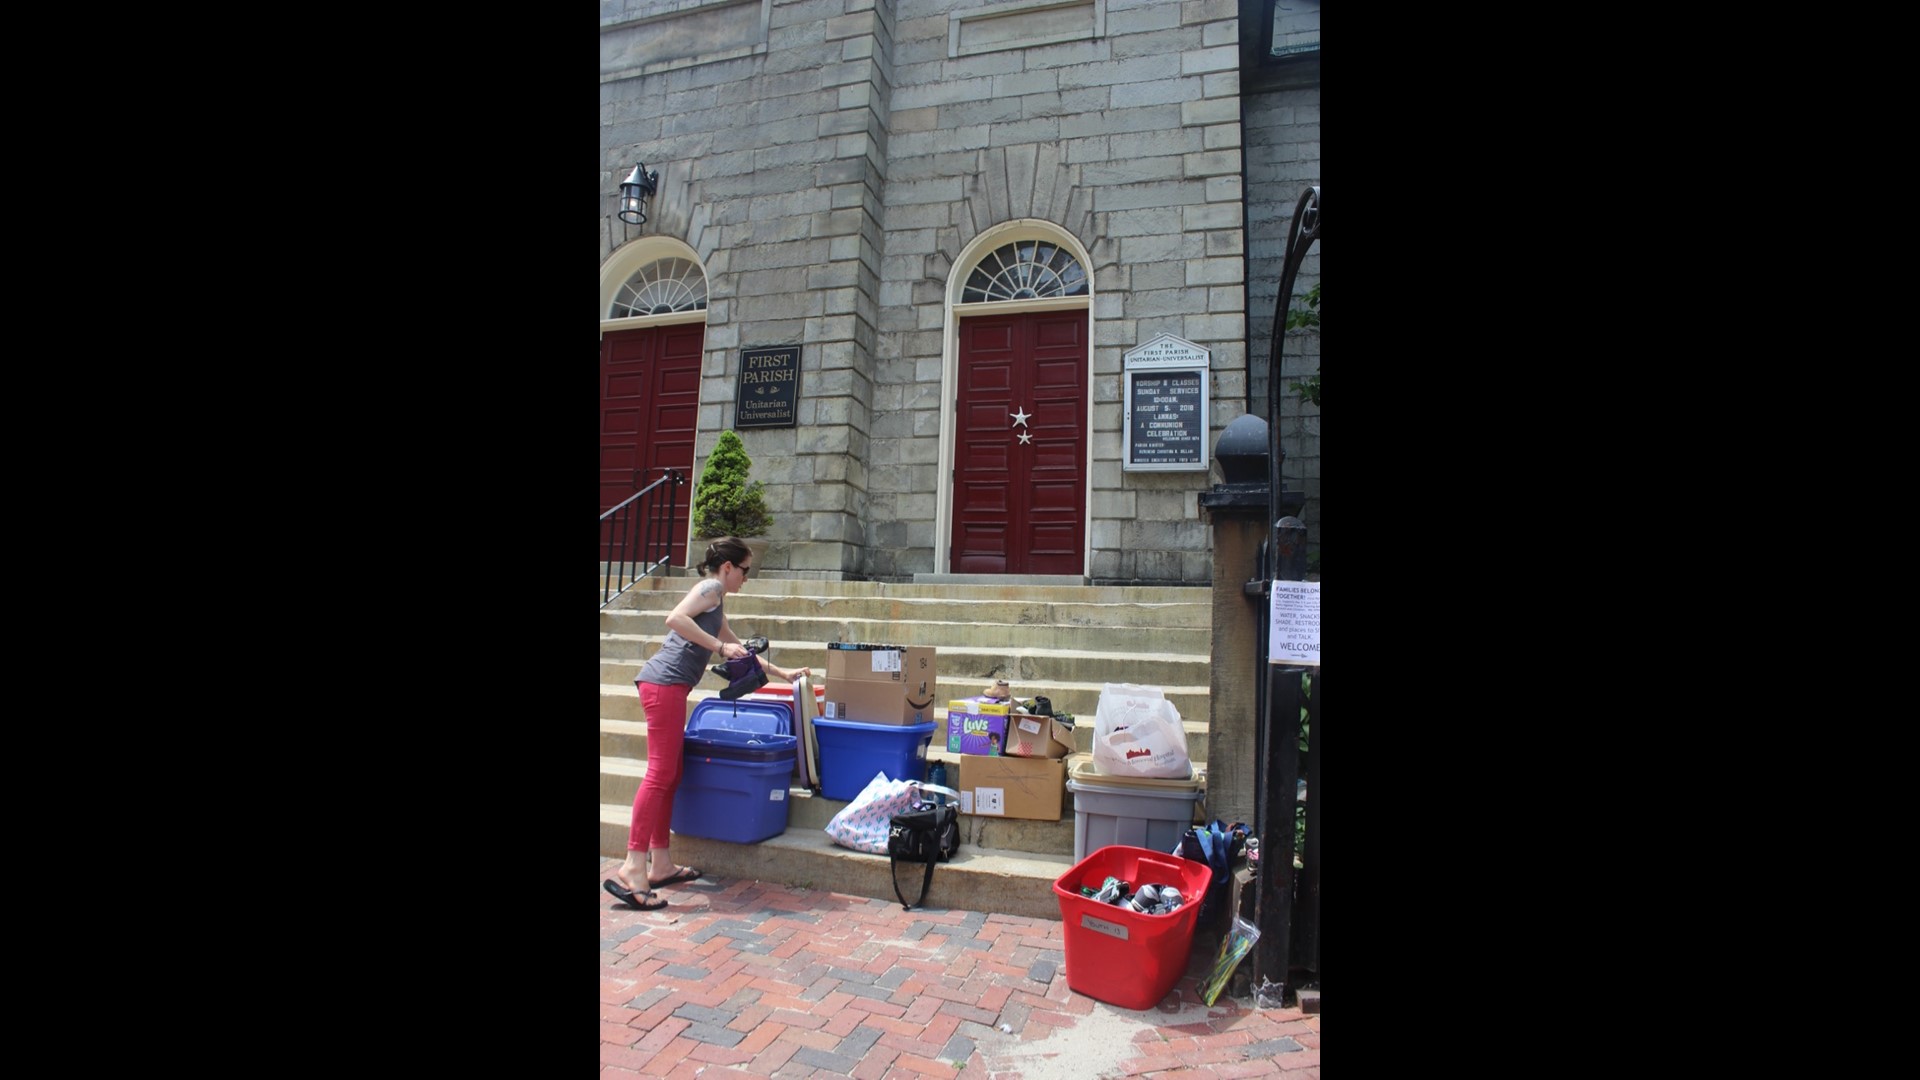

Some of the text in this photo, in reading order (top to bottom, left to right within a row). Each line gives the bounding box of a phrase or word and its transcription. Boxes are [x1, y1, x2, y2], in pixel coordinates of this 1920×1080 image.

[748, 354, 791, 369] FIRST
[743, 369, 794, 384] PARISH
[1170, 387, 1199, 395] SERVICES
[745, 399, 787, 409] Unitarian
[740, 409, 791, 420] Universalist
[1276, 586, 1300, 594] FAMILIES
[1280, 642, 1320, 652] WELCOME
